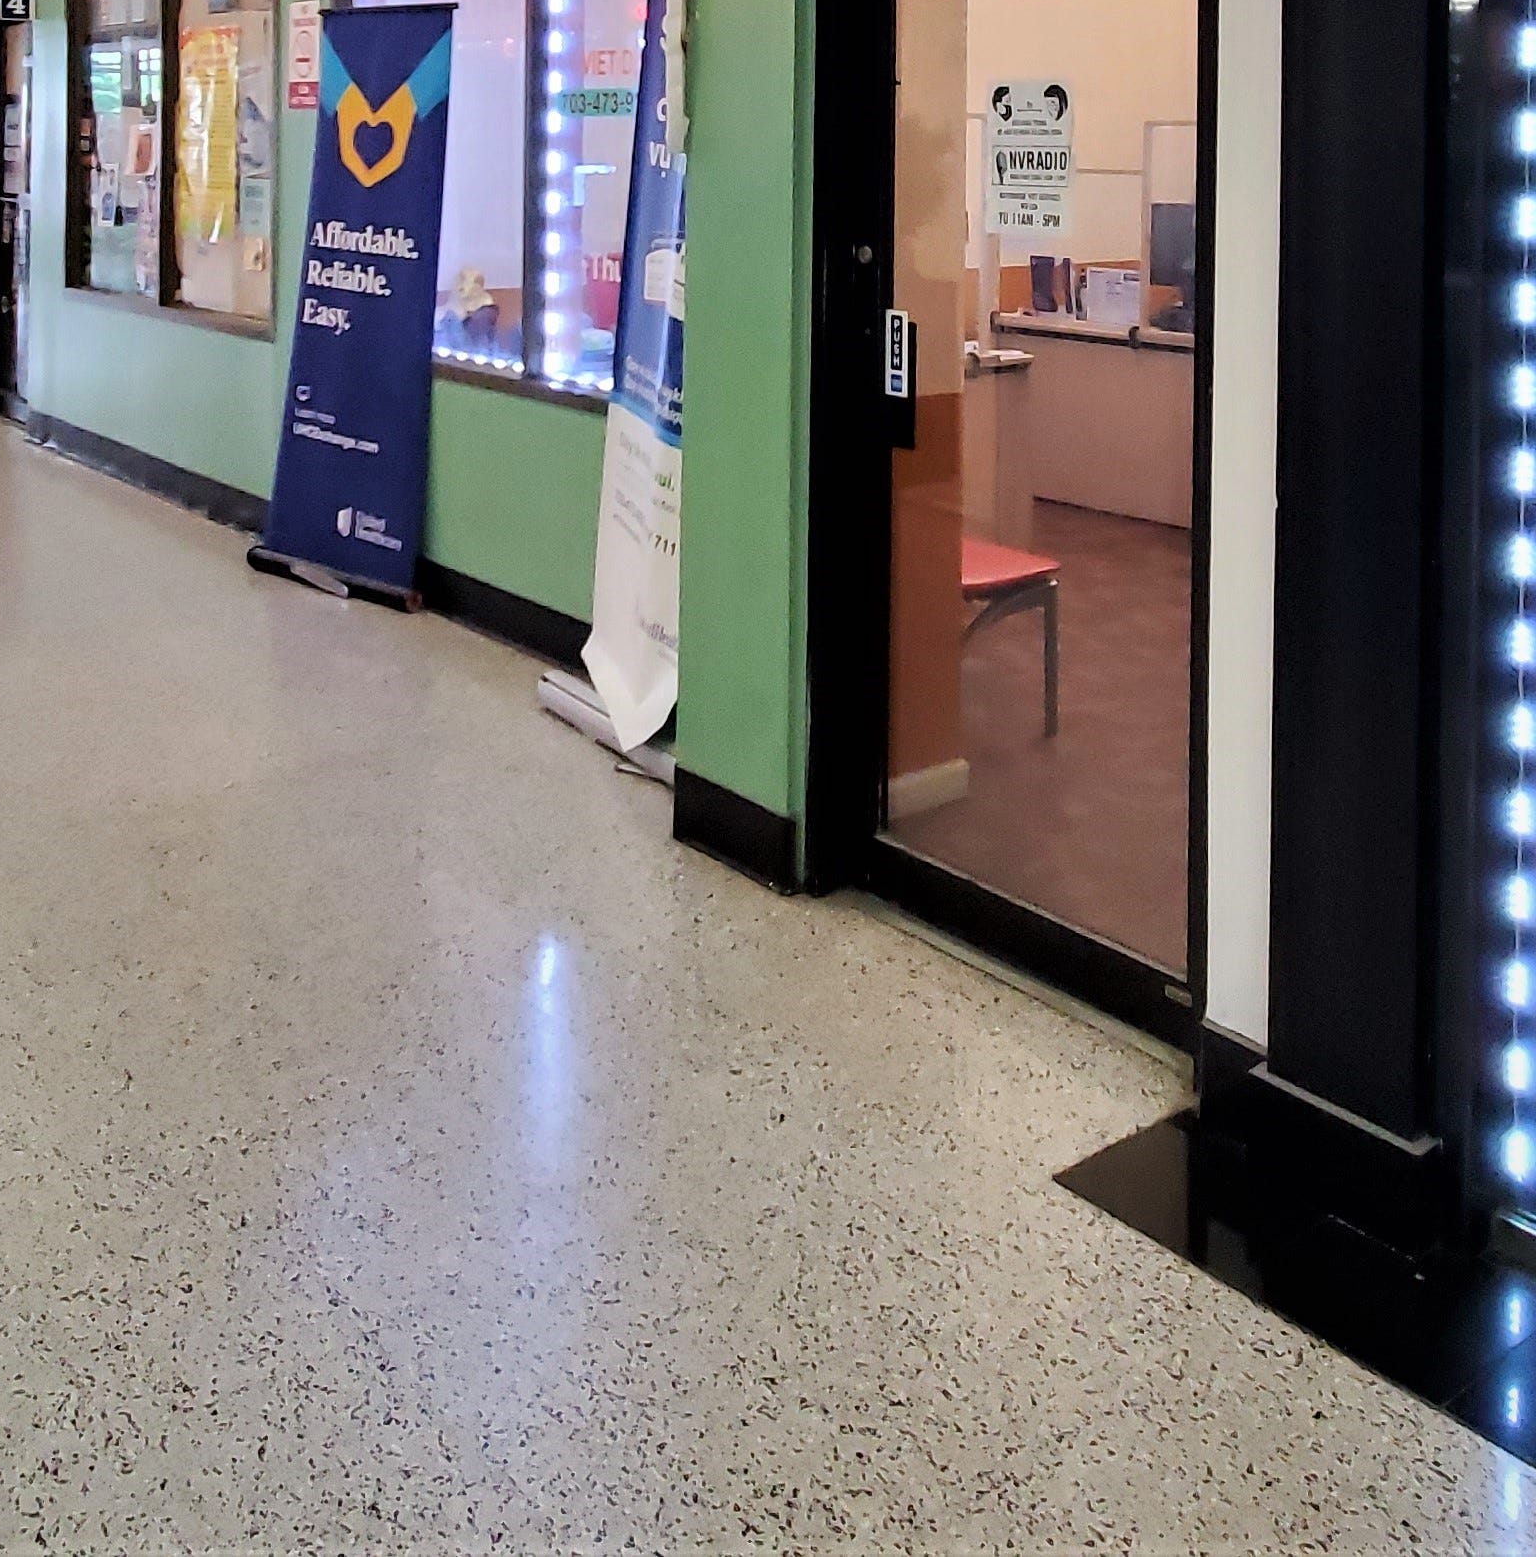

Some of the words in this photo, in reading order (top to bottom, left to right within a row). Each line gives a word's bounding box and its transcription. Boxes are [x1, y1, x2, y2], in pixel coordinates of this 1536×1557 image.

[309, 220, 420, 260] Affordable.
[306, 259, 393, 297] Reliable.
[302, 297, 351, 336] Easy.
